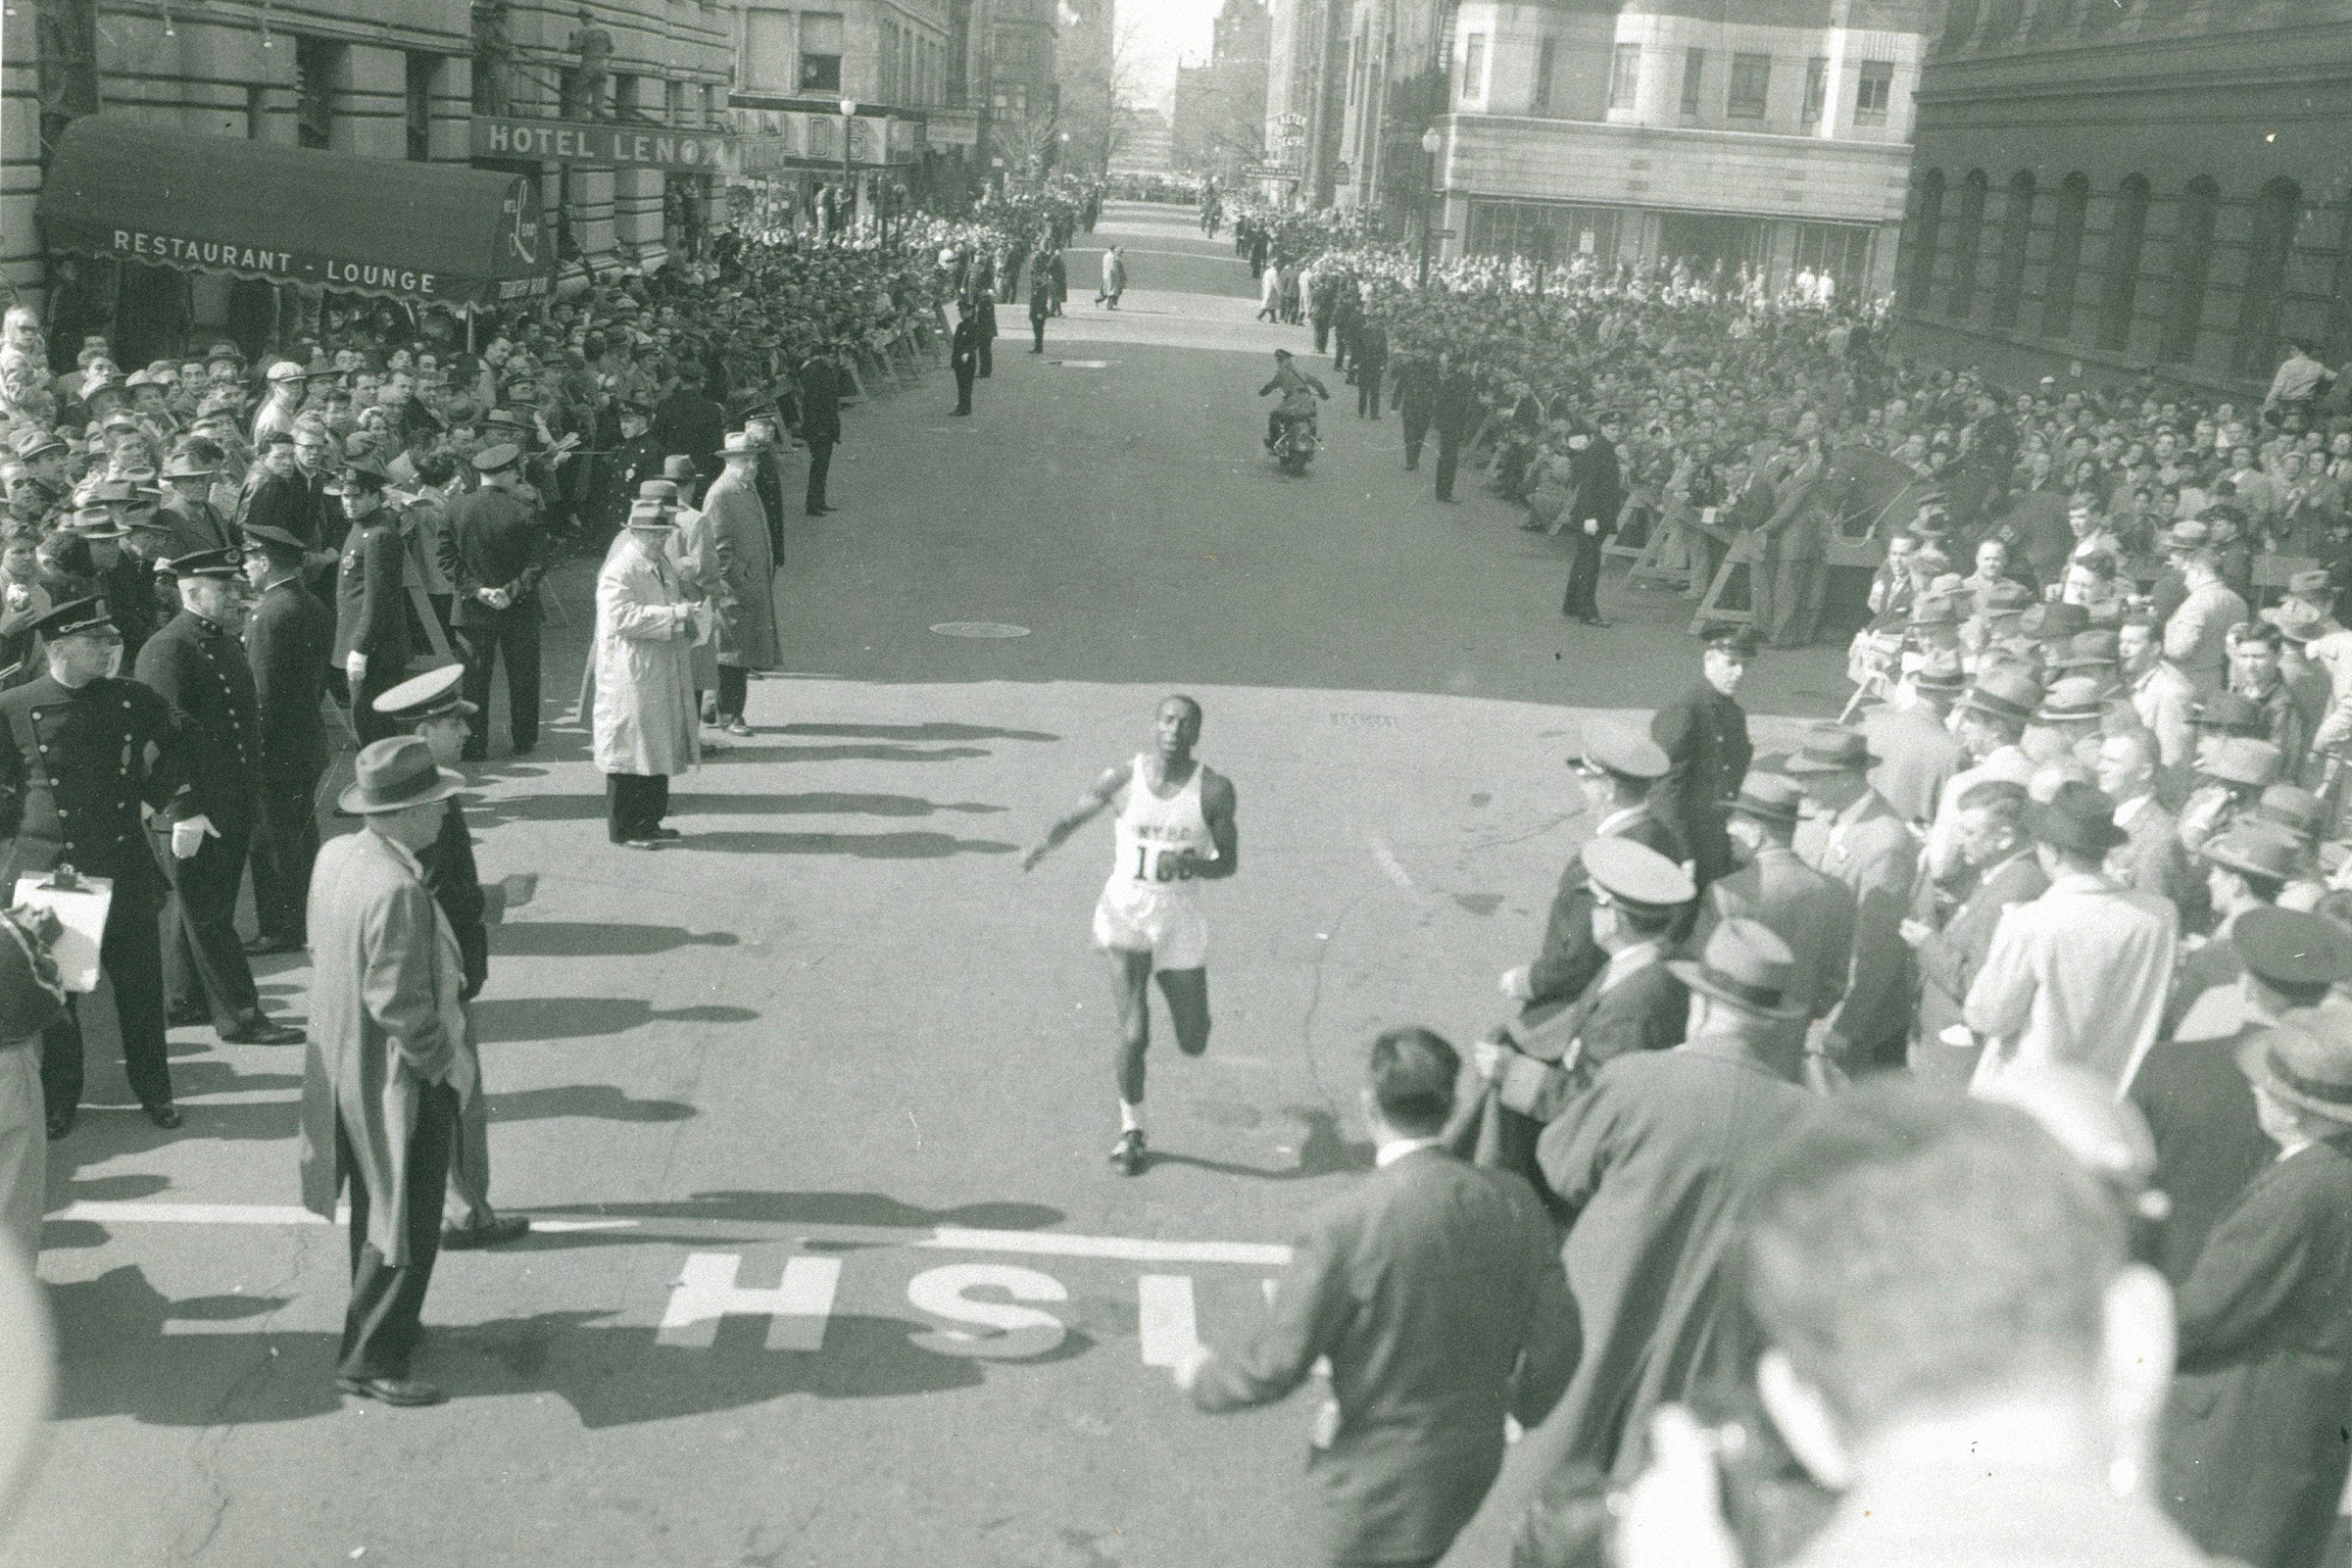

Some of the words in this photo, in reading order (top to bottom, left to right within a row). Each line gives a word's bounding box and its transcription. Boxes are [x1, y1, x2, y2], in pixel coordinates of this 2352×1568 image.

[490, 123, 595, 159] HOTEL
[114, 230, 291, 272] RESTAURANT
[327, 260, 436, 293] LOUNGE
